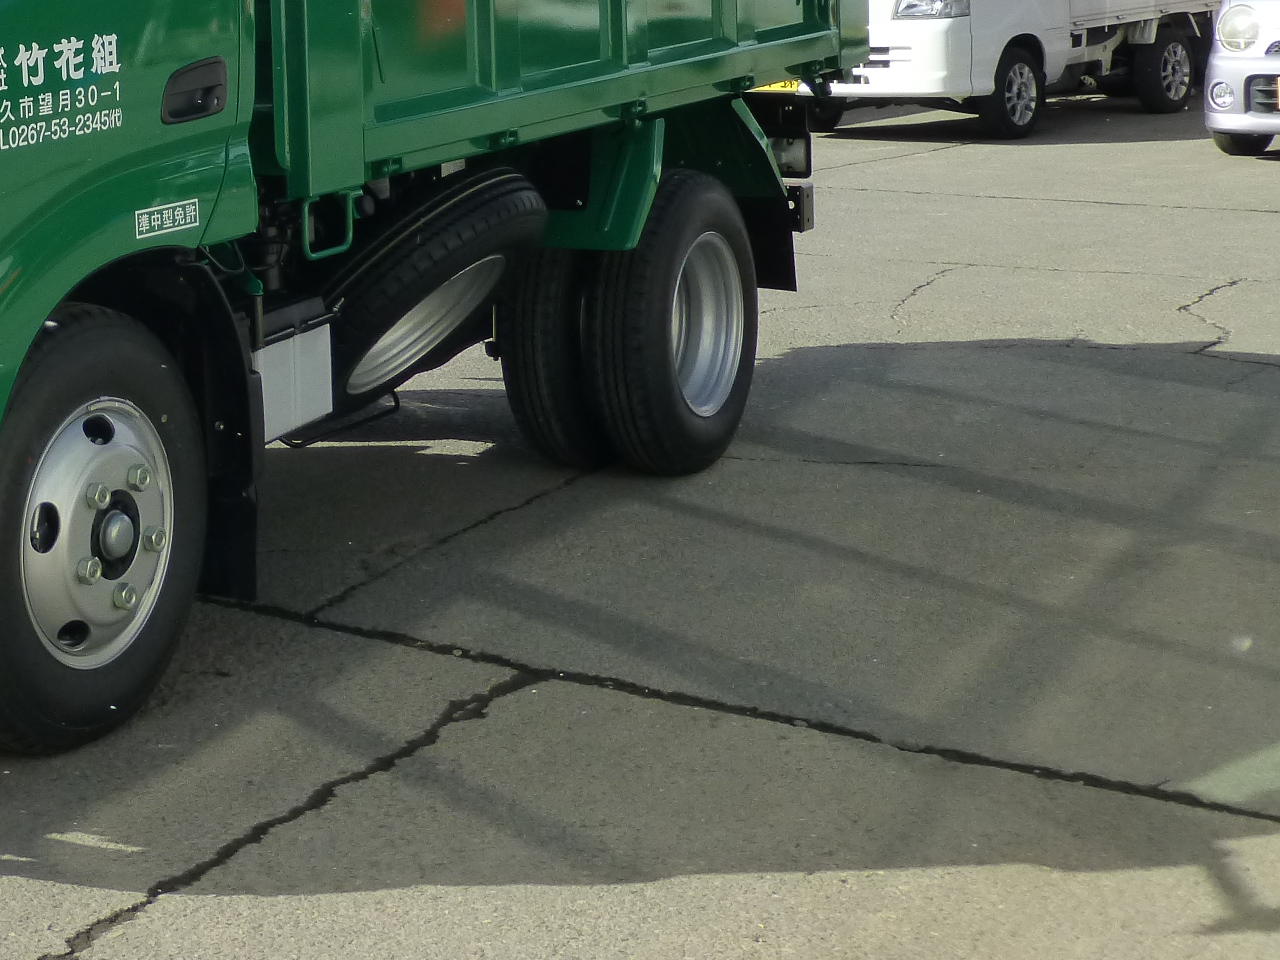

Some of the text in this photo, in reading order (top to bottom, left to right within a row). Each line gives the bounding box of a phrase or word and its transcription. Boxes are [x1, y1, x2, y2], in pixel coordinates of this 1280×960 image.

[13, 33, 121, 87] 竹花組
[138, 204, 197, 233] 準中型免許
